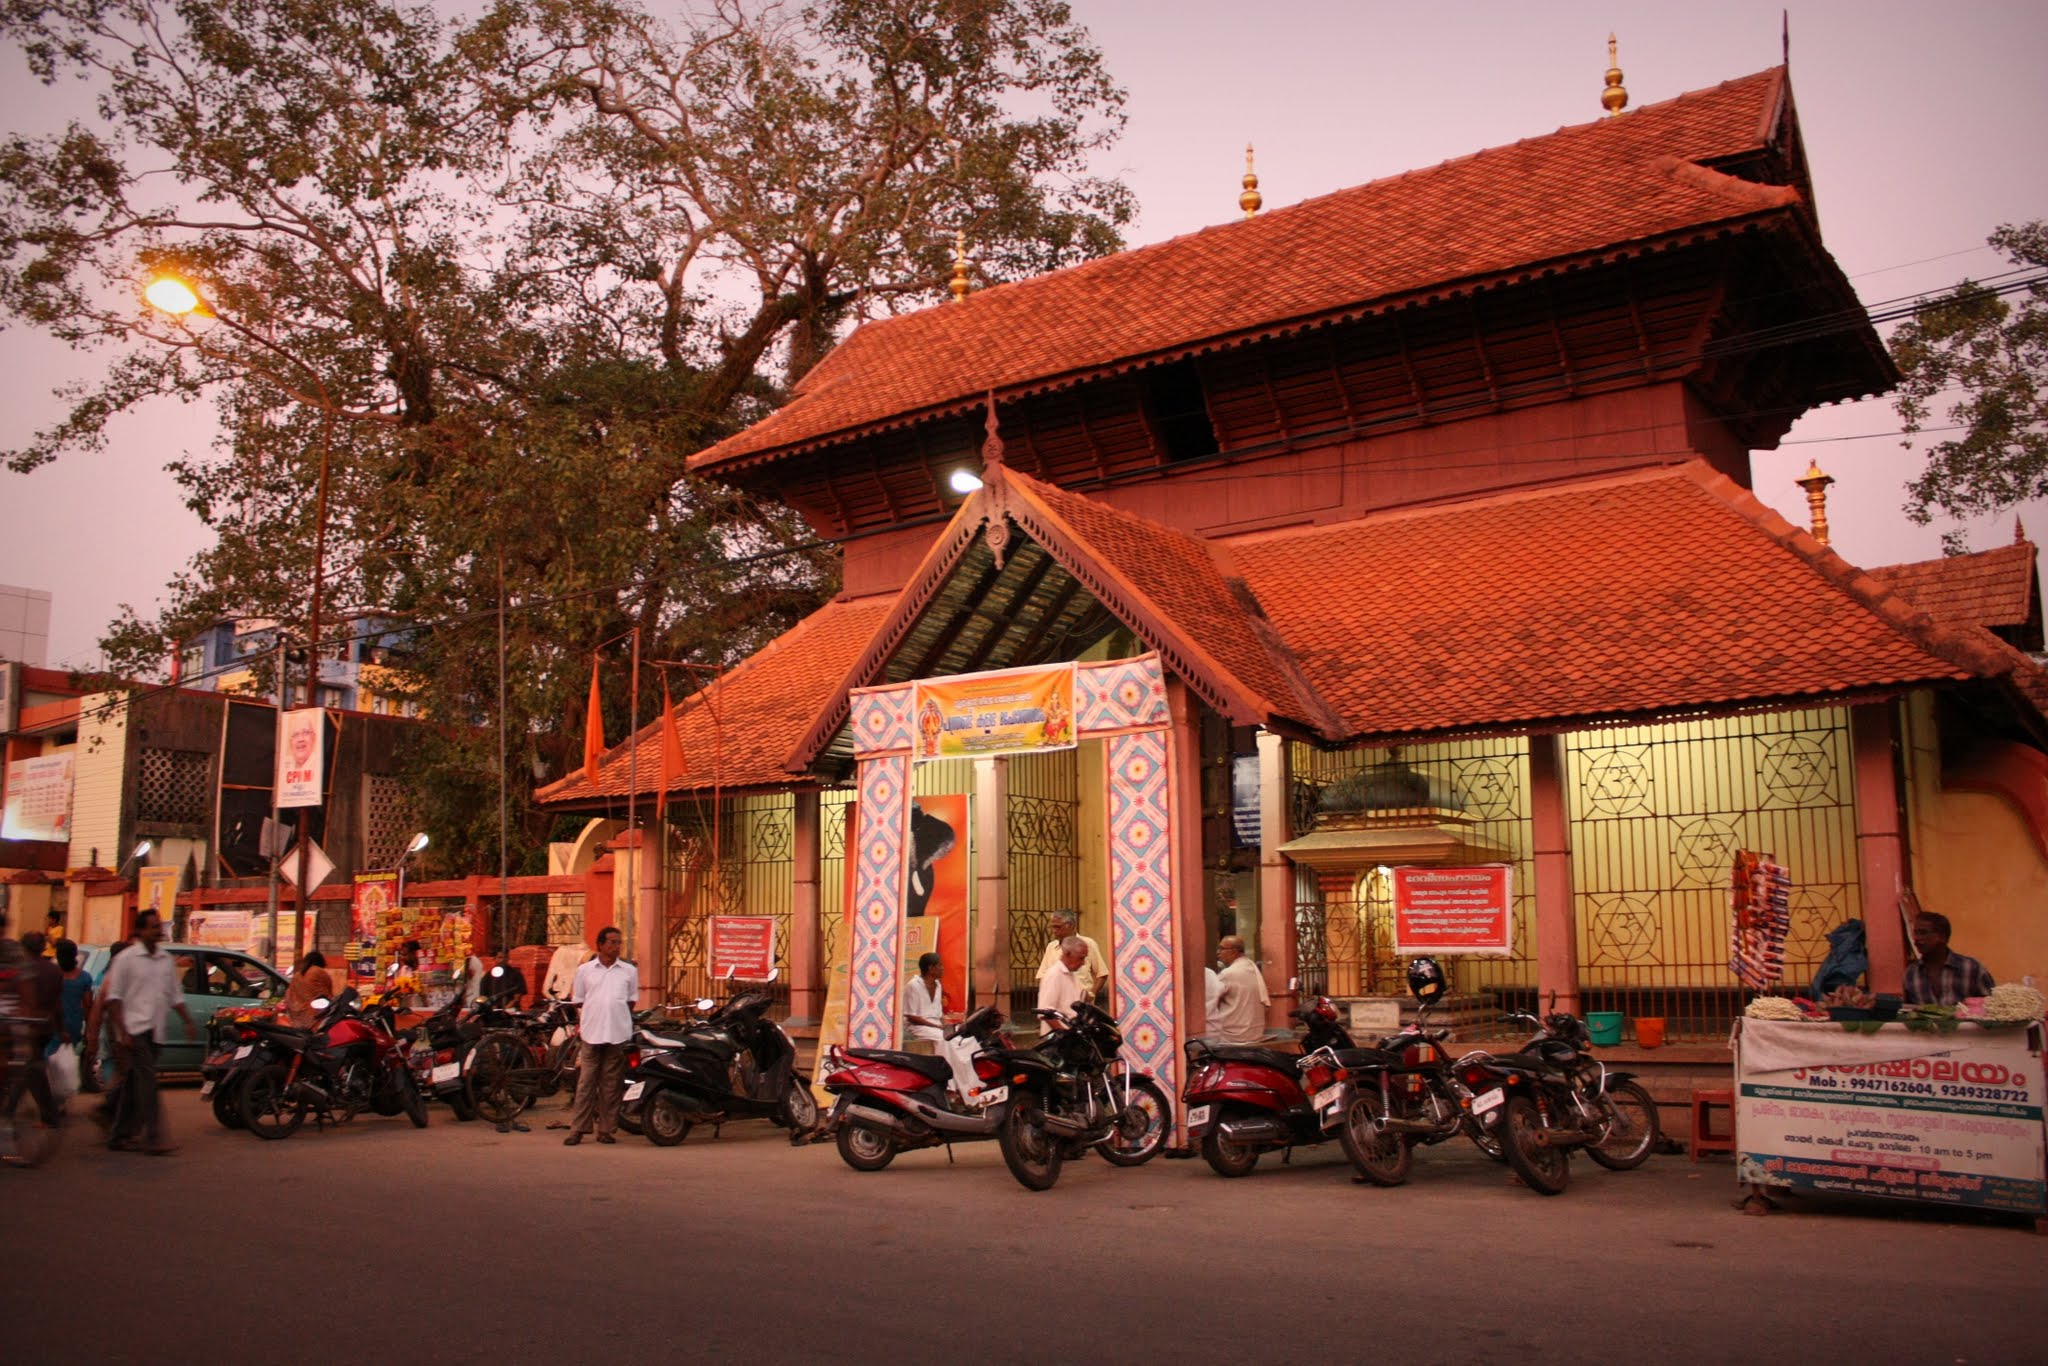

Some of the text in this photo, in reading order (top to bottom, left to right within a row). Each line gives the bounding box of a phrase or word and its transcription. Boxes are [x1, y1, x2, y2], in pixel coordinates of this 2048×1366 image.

[1809, 1076, 1838, 1088] Mob
[1850, 1078, 1937, 1097] 9947162604,
[1941, 1084, 2029, 1103] 9349328722
[1919, 1145, 1931, 1154] 10
[1934, 1147, 1950, 1156] am
[1952, 1148, 1964, 1157] to
[1966, 1149, 1973, 1158] 5
[1976, 1152, 1993, 1161] pm
